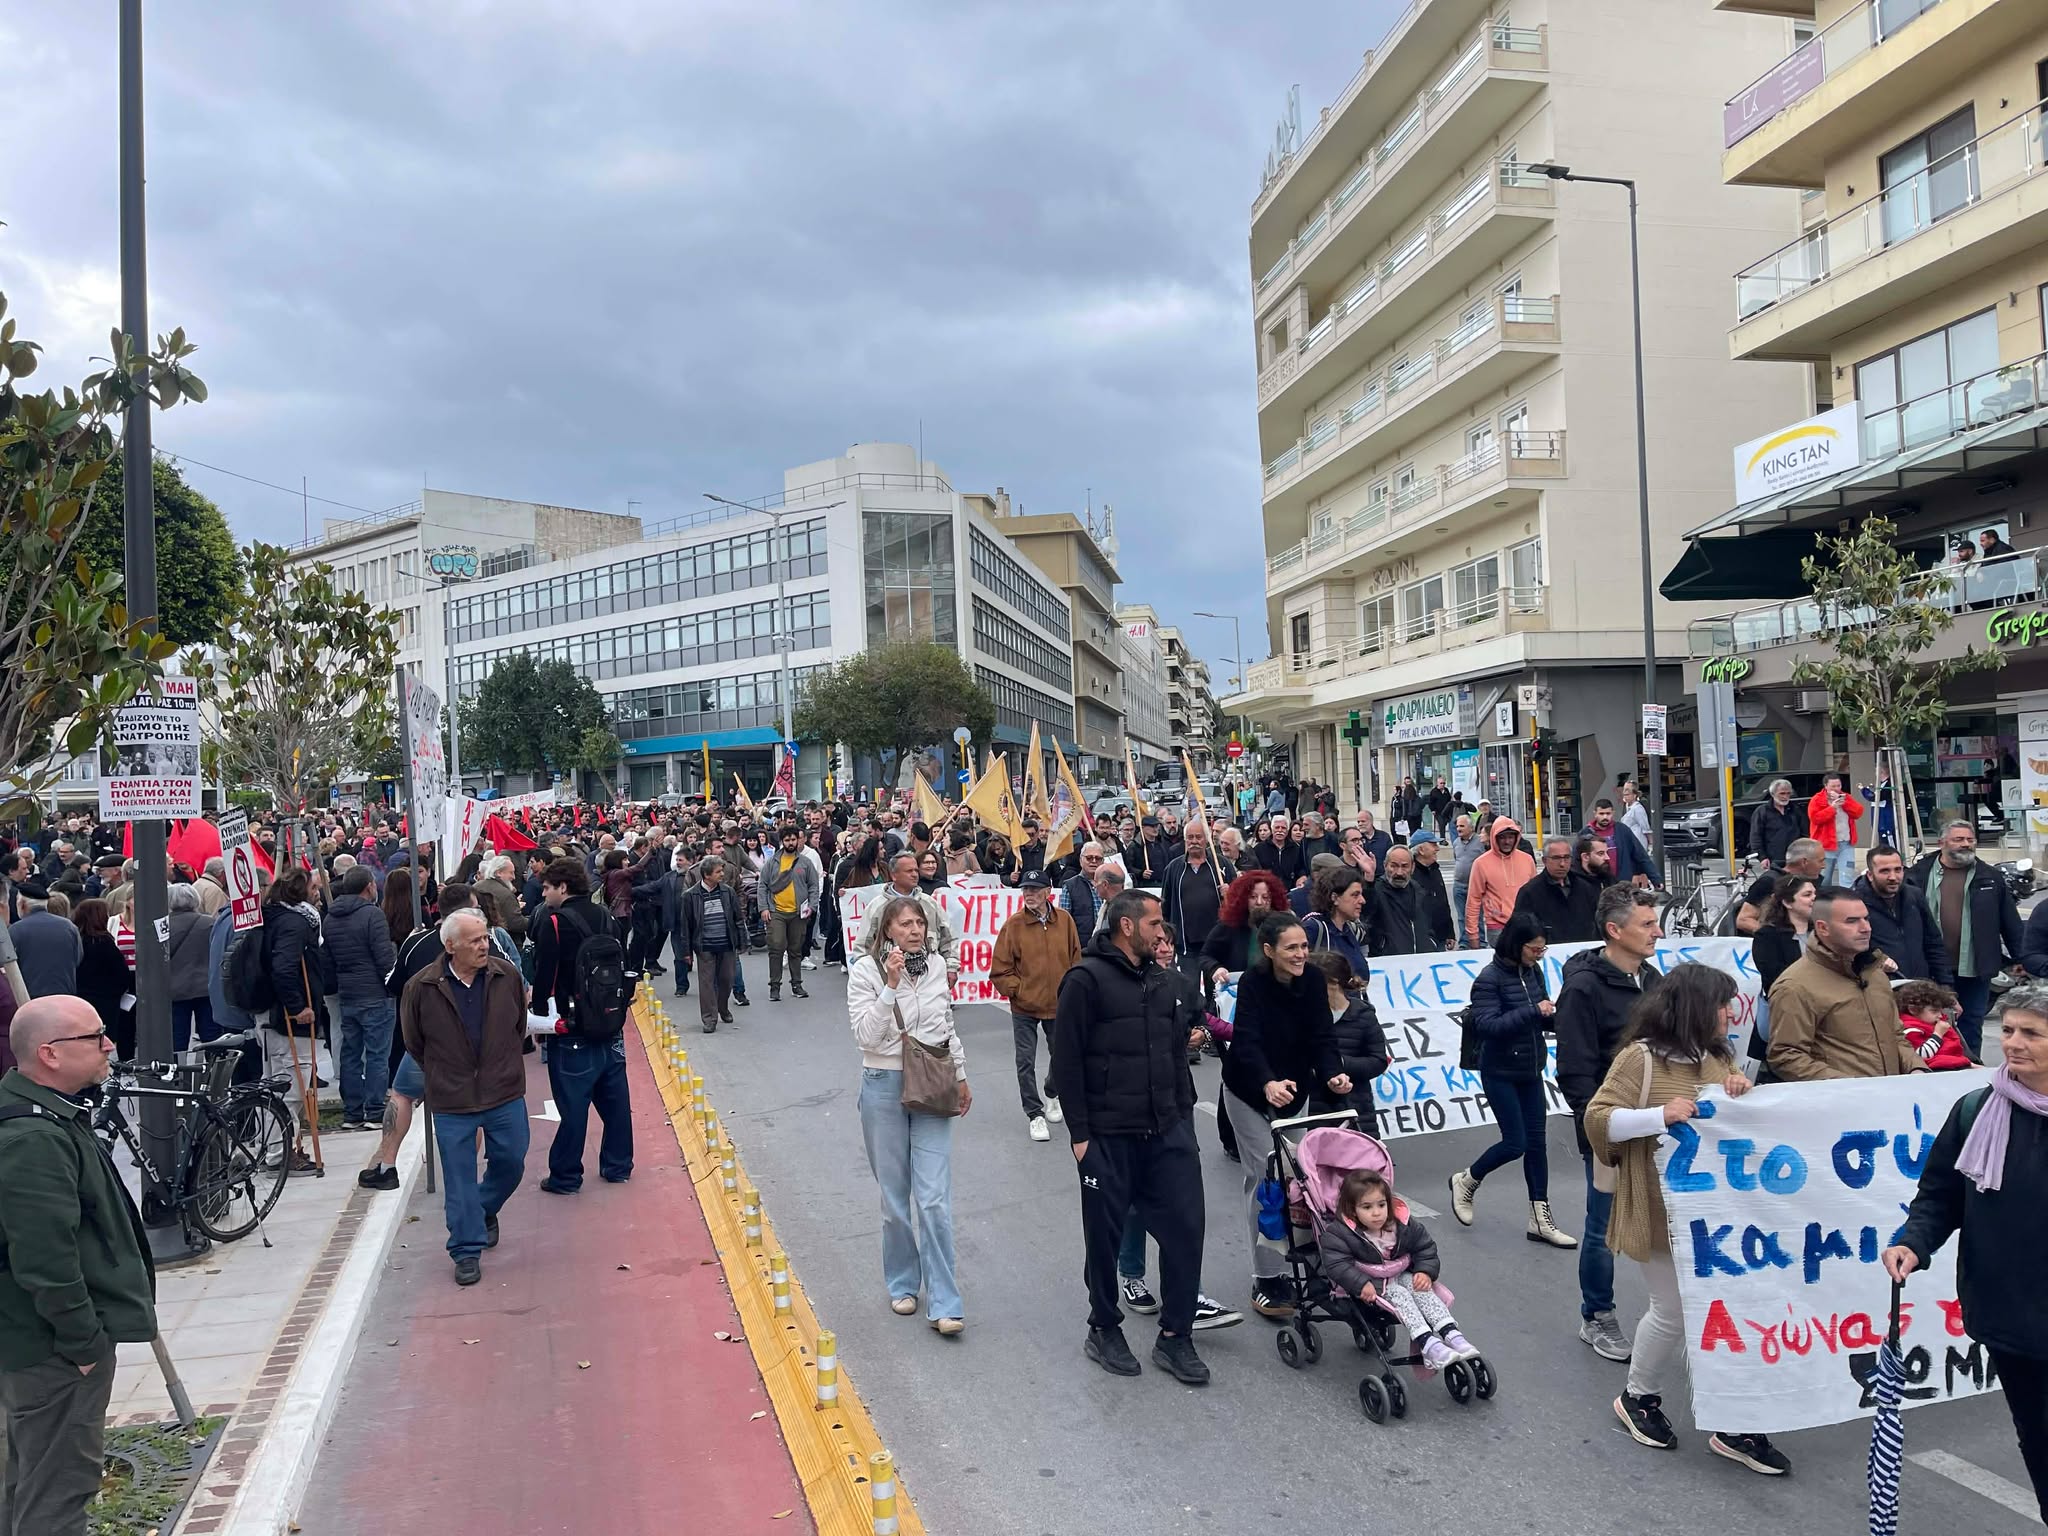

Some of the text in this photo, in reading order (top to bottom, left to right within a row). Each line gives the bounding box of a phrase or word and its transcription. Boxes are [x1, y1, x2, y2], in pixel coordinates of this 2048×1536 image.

[1762, 452, 1798, 478] KING
[1800, 440, 1830, 463] TAN
[166, 681, 194, 695] ΜΑΗ
[138, 696, 172, 709] ΑΓΡΑΣ
[173, 699, 196, 710] 10πμ
[1396, 691, 1456, 722] ΦΑΡΜΑΚΕΙΟ
[118, 715, 181, 723] ΒΑΔΙΖΟΥΜΕ ΤΟ
[112, 722, 190, 732] ΔΡΟΜΟ ΤΗΣ
[113, 731, 190, 741] ΑΝΑΤΡΟΠΗΣ
[110, 780, 192, 789] ΕΝΑΝΤΙΑ ΣΤΟΝ
[110, 789, 191, 798] ΠΟΛΕΜΟ ΚΑΙ
